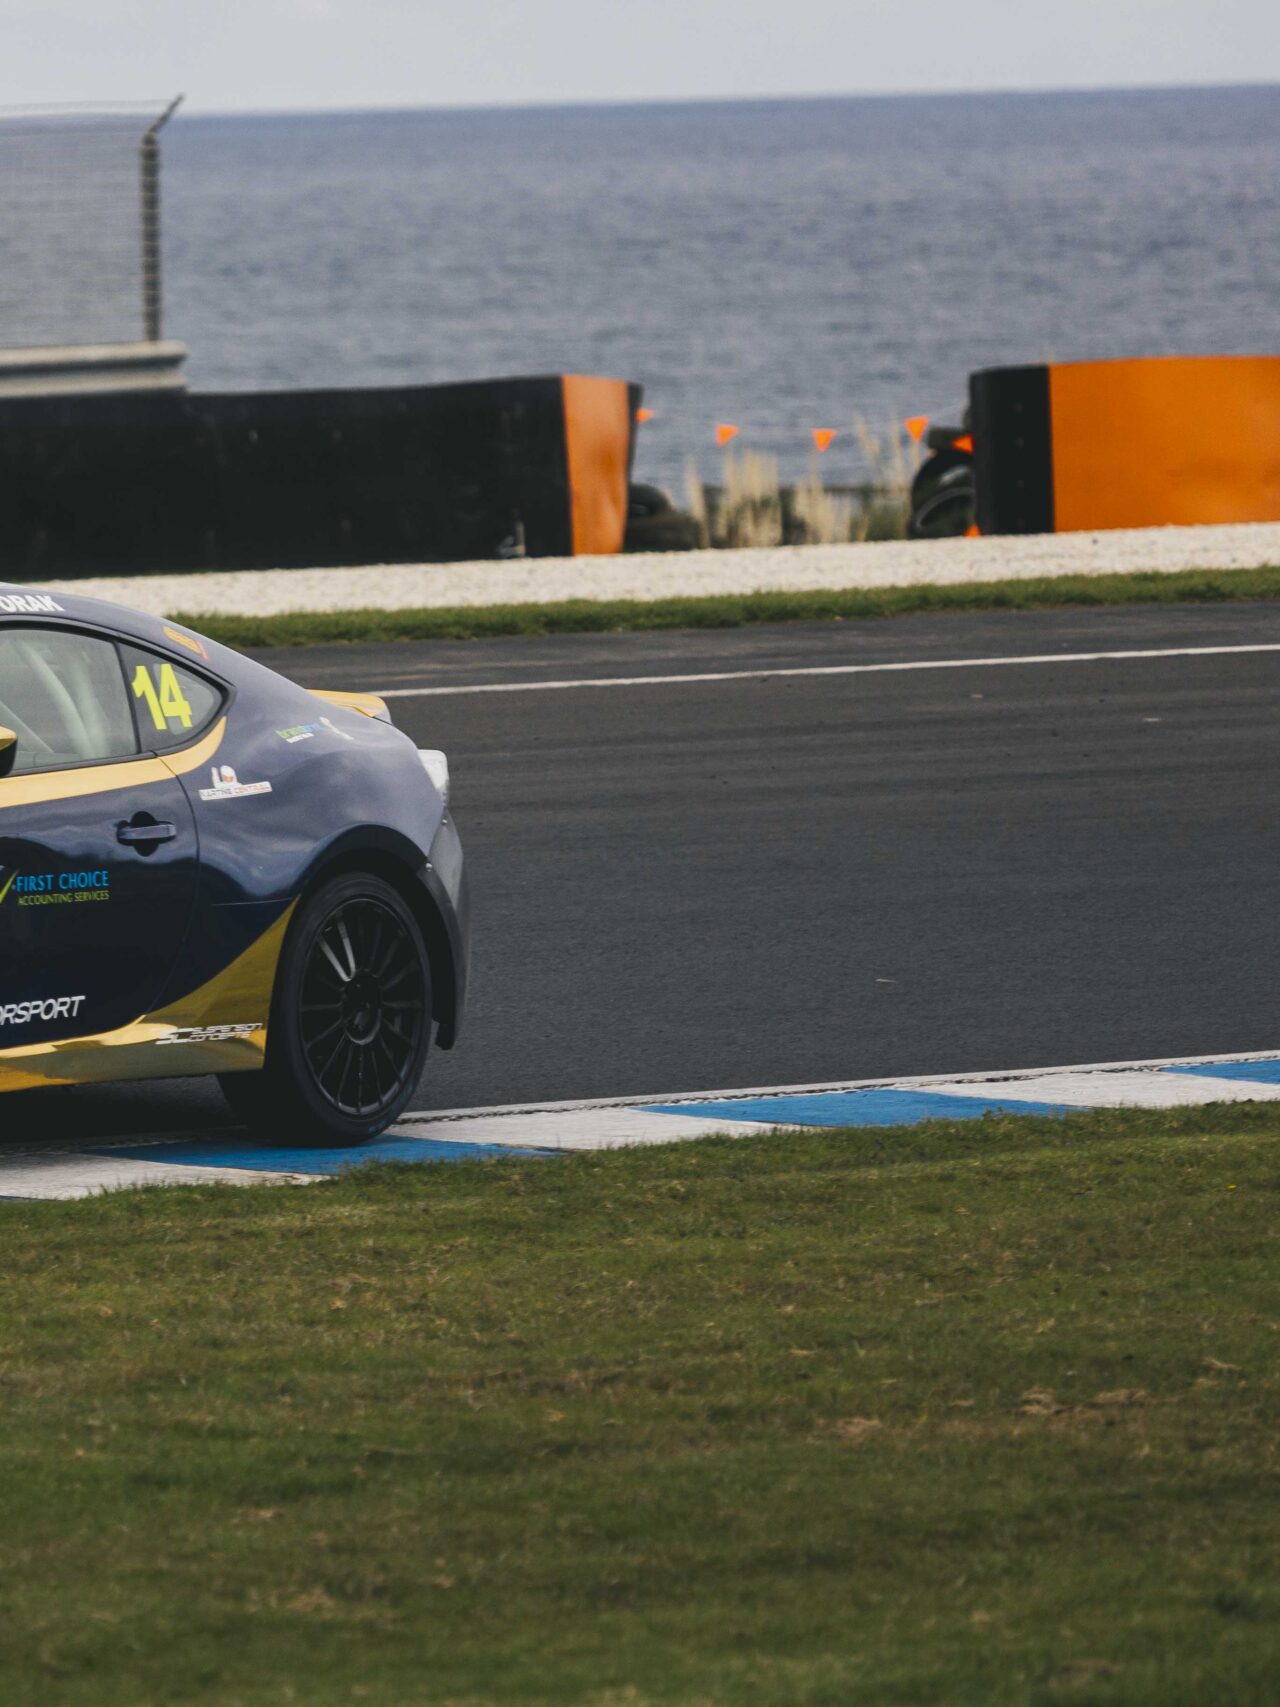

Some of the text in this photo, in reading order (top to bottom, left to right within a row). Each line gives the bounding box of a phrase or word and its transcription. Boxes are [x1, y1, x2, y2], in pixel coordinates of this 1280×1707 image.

[131, 663, 193, 730] 14
[16, 870, 110, 893] FIRST CHOICE
[18, 889, 111, 906] ACCOUNTING SERVICES
